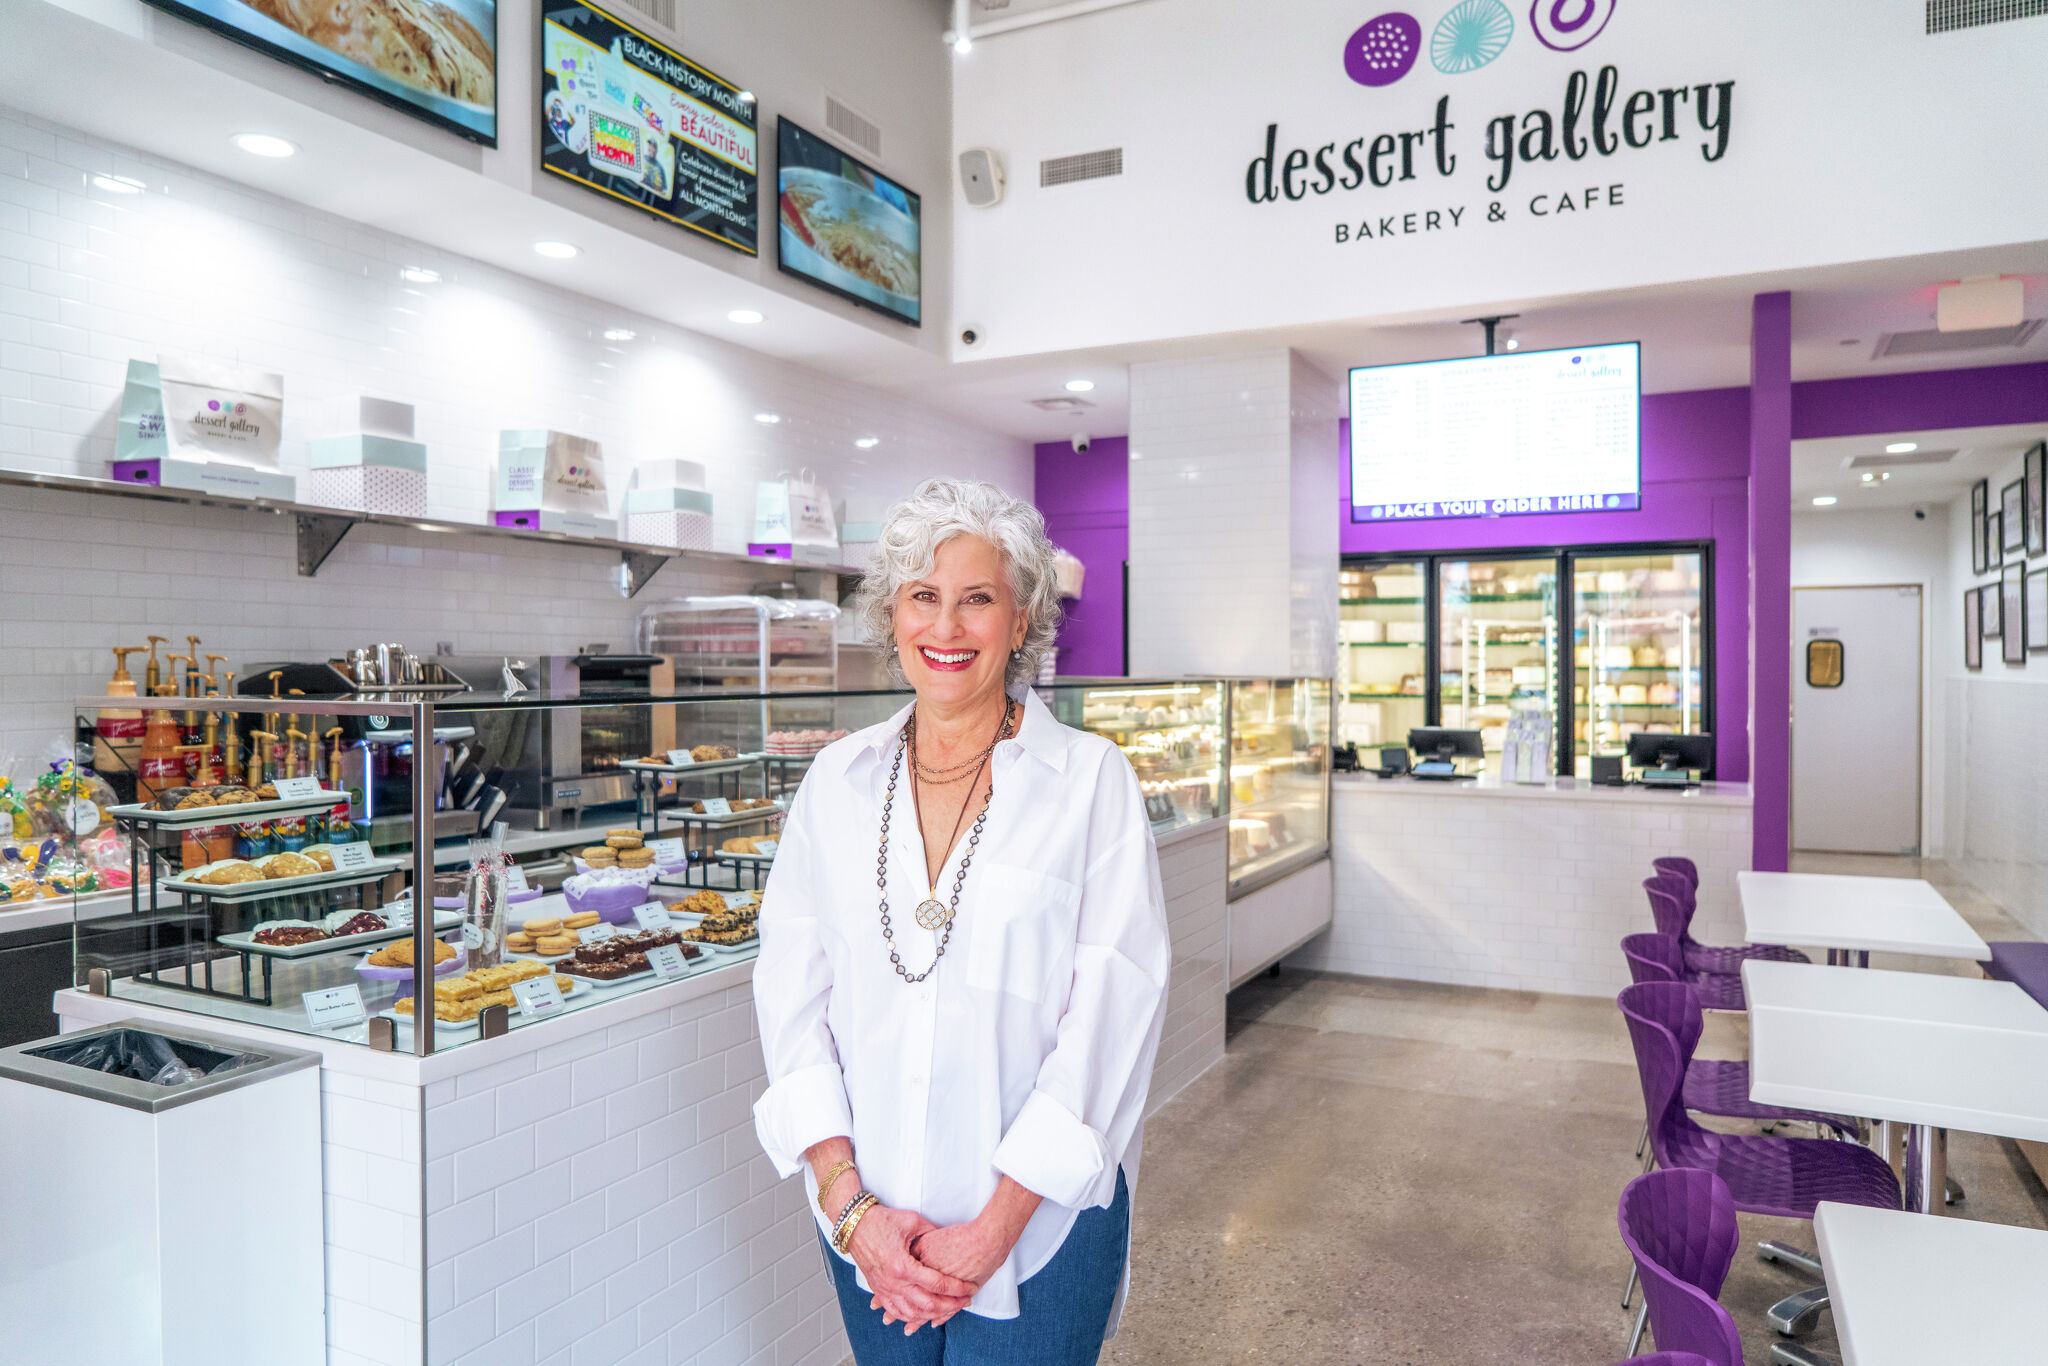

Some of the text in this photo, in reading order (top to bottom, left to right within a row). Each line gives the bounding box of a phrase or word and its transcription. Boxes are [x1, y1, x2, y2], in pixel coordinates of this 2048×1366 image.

[624, 38, 752, 120] BLACK HISTORY MONTH
[670, 92, 699, 120] Every
[701, 114, 726, 133] color
[681, 115, 752, 166] BEAUTIFUL
[1246, 65, 1735, 204] dessert gallery
[596, 141, 635, 167] MONTH
[682, 152, 713, 175] Celebrate
[678, 163, 699, 181] honor
[699, 174, 731, 196] prominent
[694, 183, 734, 209] Houstonians
[680, 189, 747, 227] ALL MONTH LONG
[1335, 183, 1626, 244] BAKERY & CAFE
[194, 410, 260, 437] dessert gallery
[1384, 494, 1604, 518] PLACE YOUR ORDER HERE
[112, 721, 141, 736] Torani
